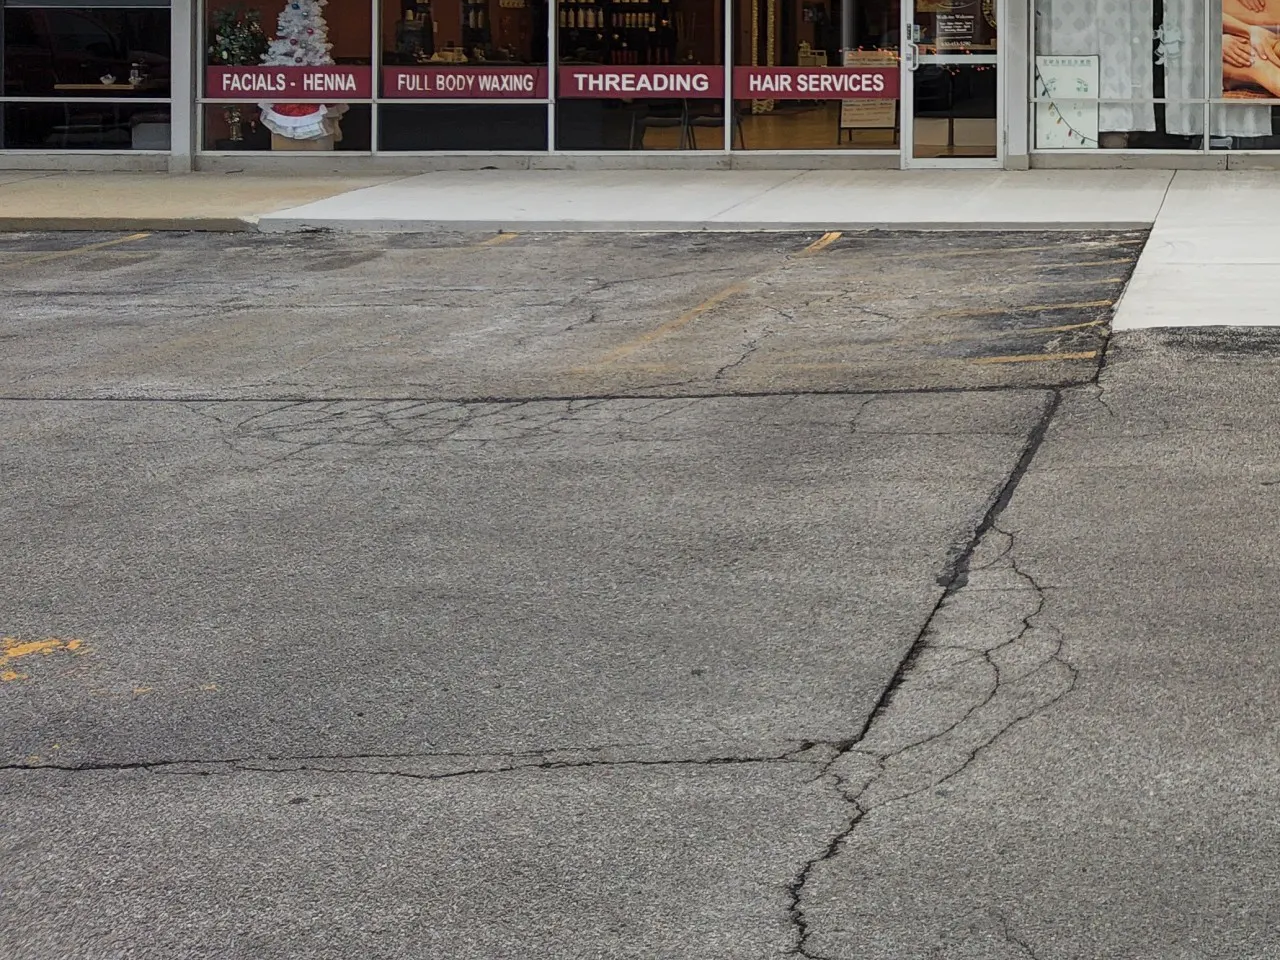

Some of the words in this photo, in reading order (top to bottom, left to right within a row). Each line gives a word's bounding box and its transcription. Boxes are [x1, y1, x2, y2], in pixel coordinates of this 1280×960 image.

[222, 73, 287, 92] FACIALS
[303, 73, 357, 92] HENNA
[398, 74, 430, 92] FULL
[436, 74, 475, 92] BODY
[478, 74, 534, 92] WAXING
[574, 73, 709, 92] THREADING
[749, 74, 793, 92] HAIR
[797, 73, 885, 92] SERVICES
